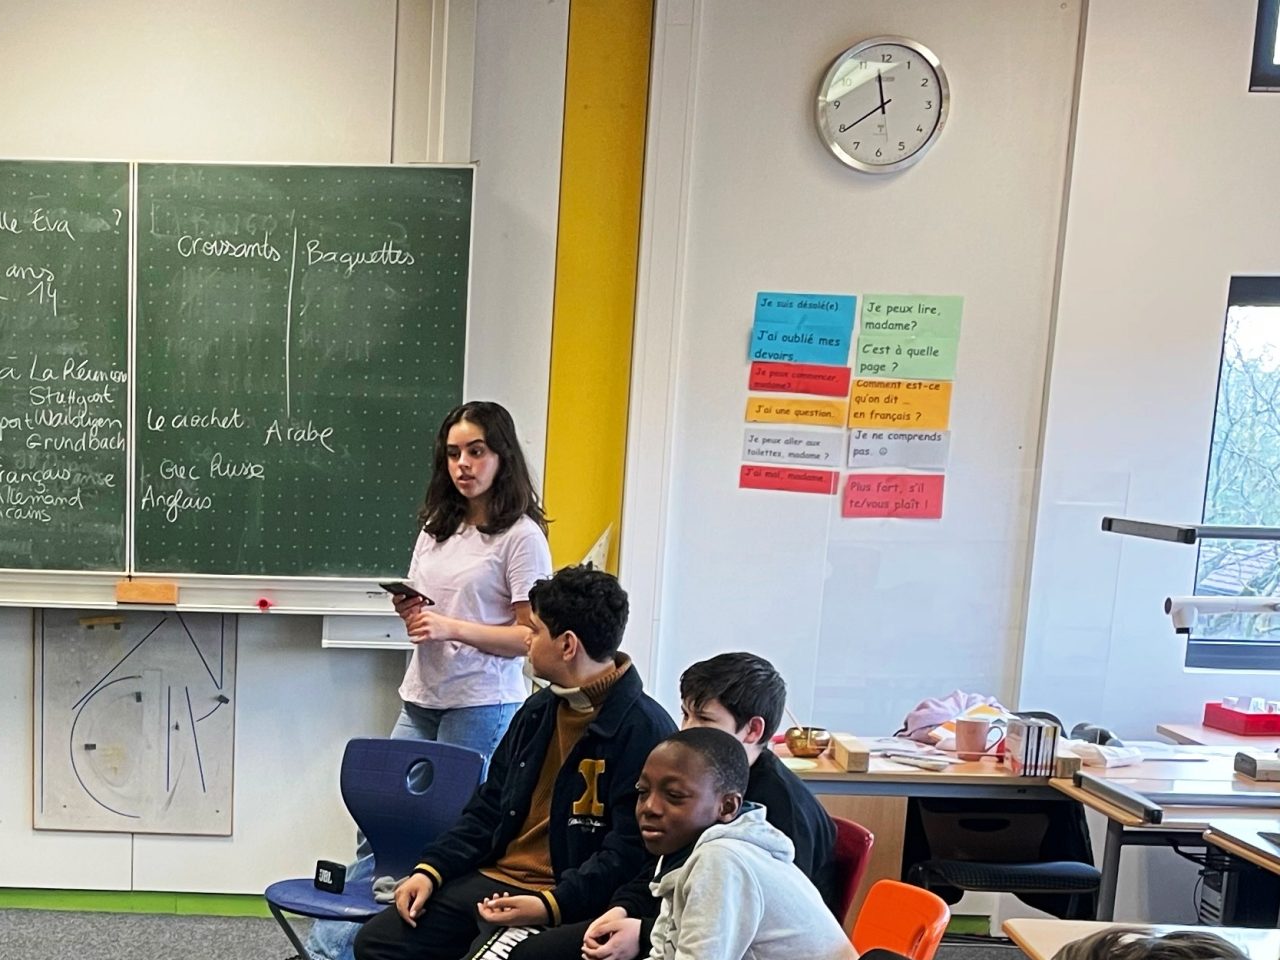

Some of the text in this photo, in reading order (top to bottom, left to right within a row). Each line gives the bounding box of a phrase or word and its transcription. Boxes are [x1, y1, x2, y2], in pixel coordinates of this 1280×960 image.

[881, 54, 892, 63] 12
[921, 78, 929, 87] 2
[834, 101, 841, 109] 9
[925, 101, 932, 109] 3
[853, 142, 860, 150] 7
[898, 142, 905, 150] 5
[875, 148, 882, 157] 6
[177, 230, 281, 261] Croissants
[307, 239, 415, 278] Baguettes
[6, 265, 55, 281] ans
[27, 280, 57, 316] 14
[760, 298, 772, 307] Je
[867, 302, 881, 312] Je
[886, 304, 913, 315] peux
[865, 320, 918, 331] madame?
[757, 330, 840, 347] J'ai oublié mes
[862, 343, 940, 358] C'est à quelle
[30, 354, 59, 381] La
[859, 363, 886, 374] page
[856, 379, 941, 391] Comment est-ce
[854, 394, 880, 404] qu'on
[883, 394, 898, 404] dit
[755, 404, 772, 413] J'ai
[775, 407, 790, 415] une
[147, 408, 166, 431] le
[853, 411, 865, 419] en
[870, 410, 911, 422] français
[263, 419, 335, 453] Arabe
[748, 434, 759, 443] Je
[854, 430, 942, 442] Je ne comprends
[850, 481, 871, 492] Plus
[908, 482, 924, 493] s'il
[141, 484, 212, 523] Anglais
